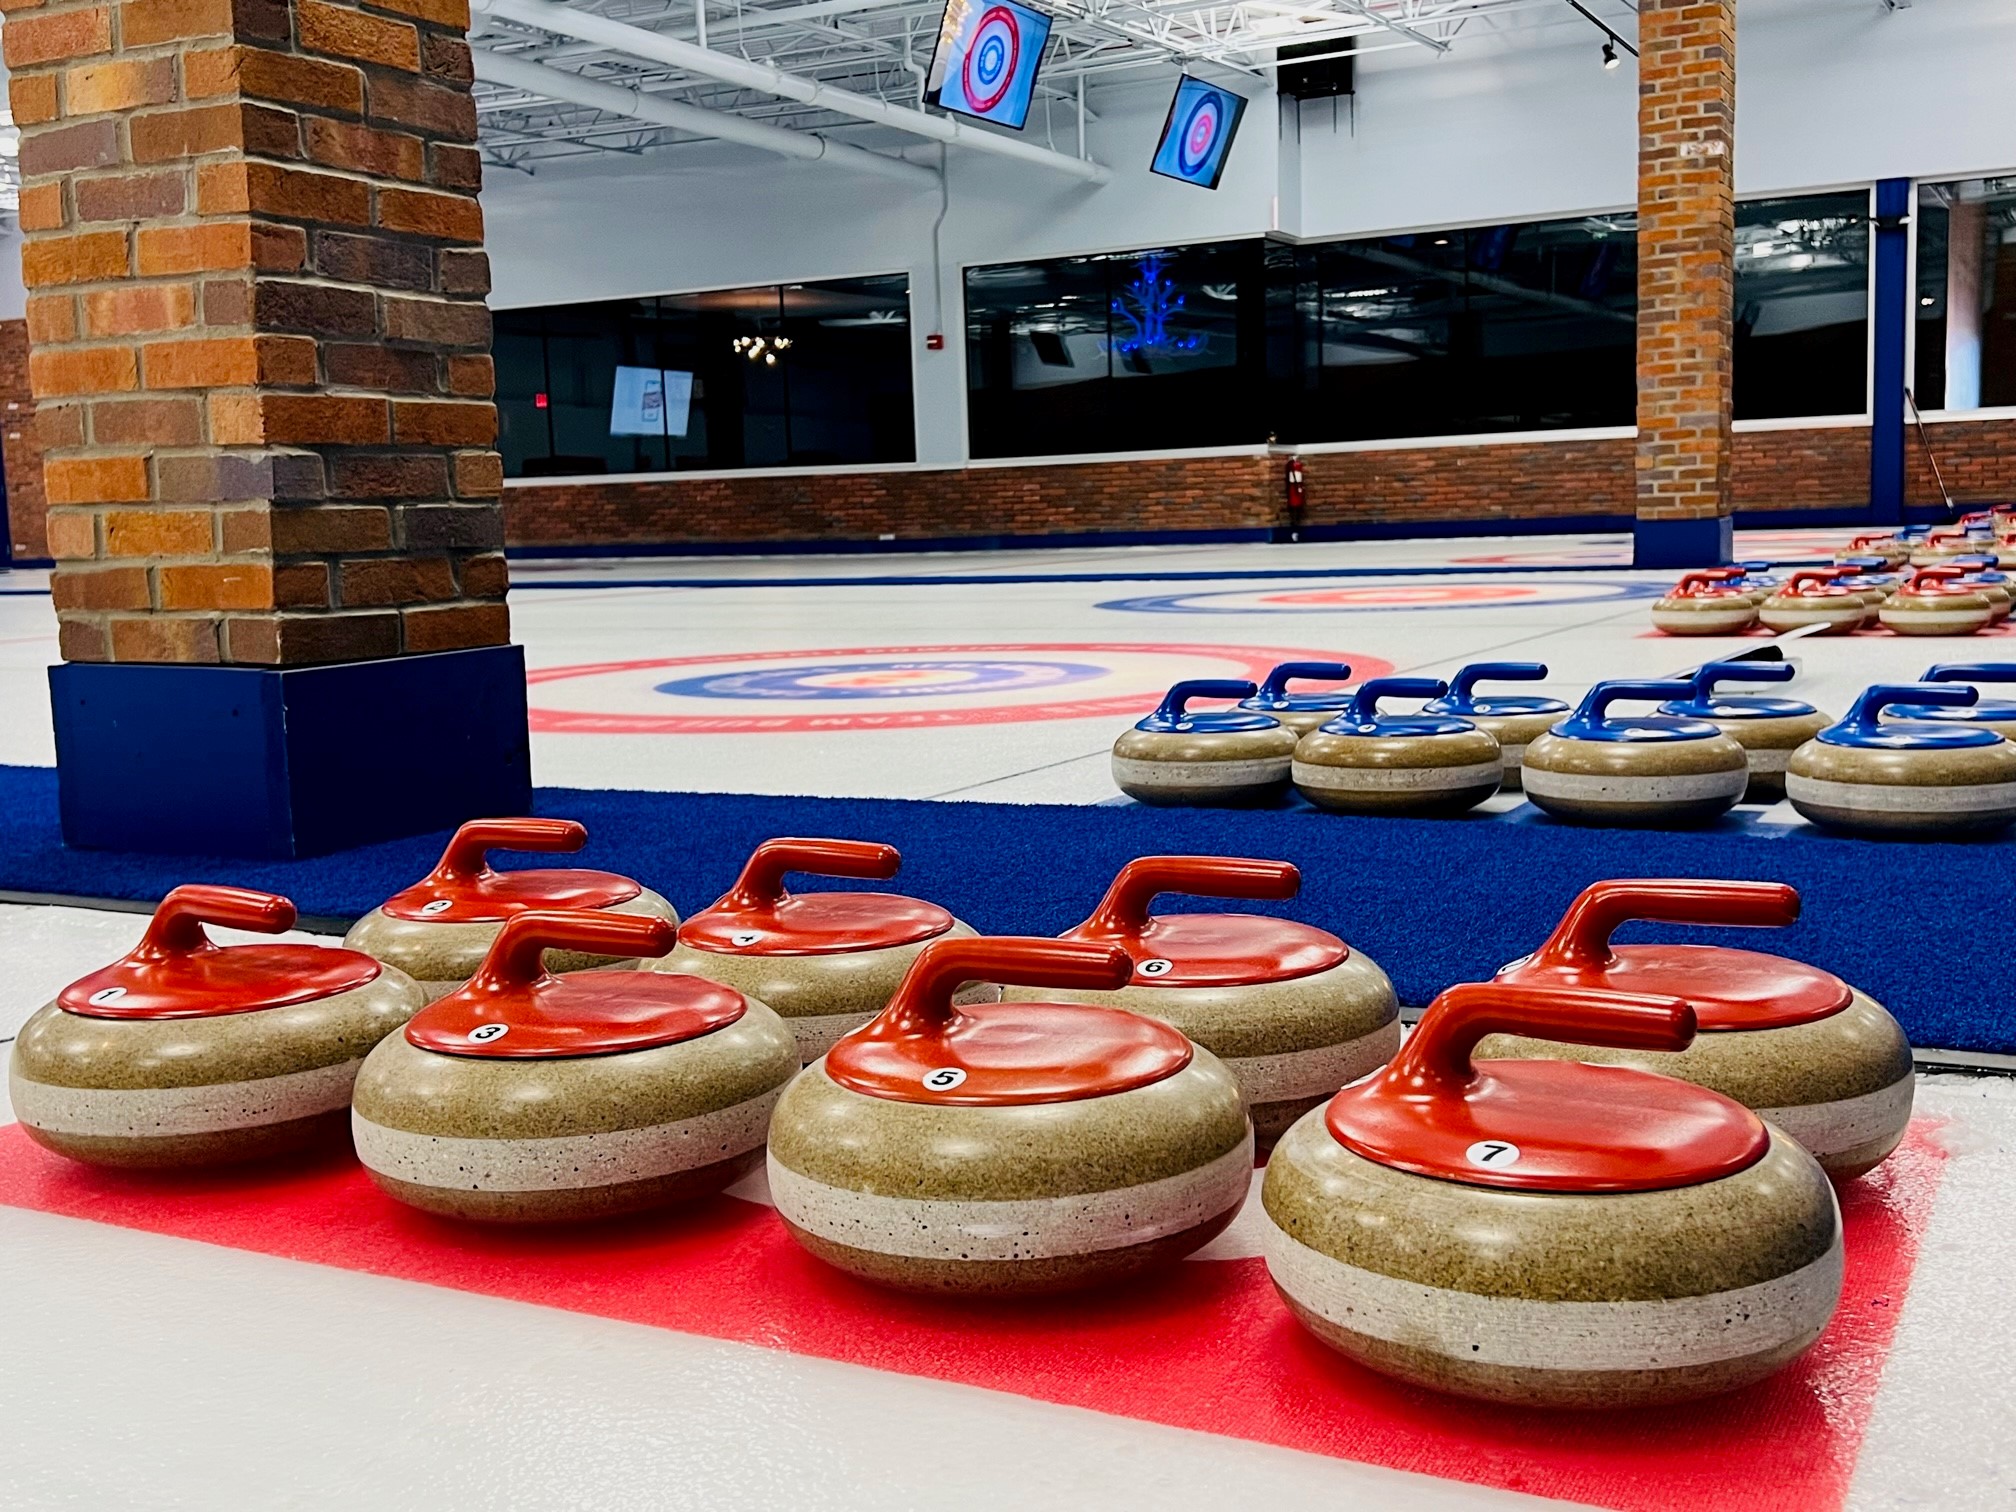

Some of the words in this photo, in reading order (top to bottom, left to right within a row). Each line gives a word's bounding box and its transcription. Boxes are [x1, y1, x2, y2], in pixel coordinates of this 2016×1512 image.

[1145, 961, 1165, 972] 6
[98, 990, 118, 1000] 1
[475, 1026, 501, 1039] 3
[931, 1071, 958, 1085] 5
[1481, 1144, 1508, 1161] 7
